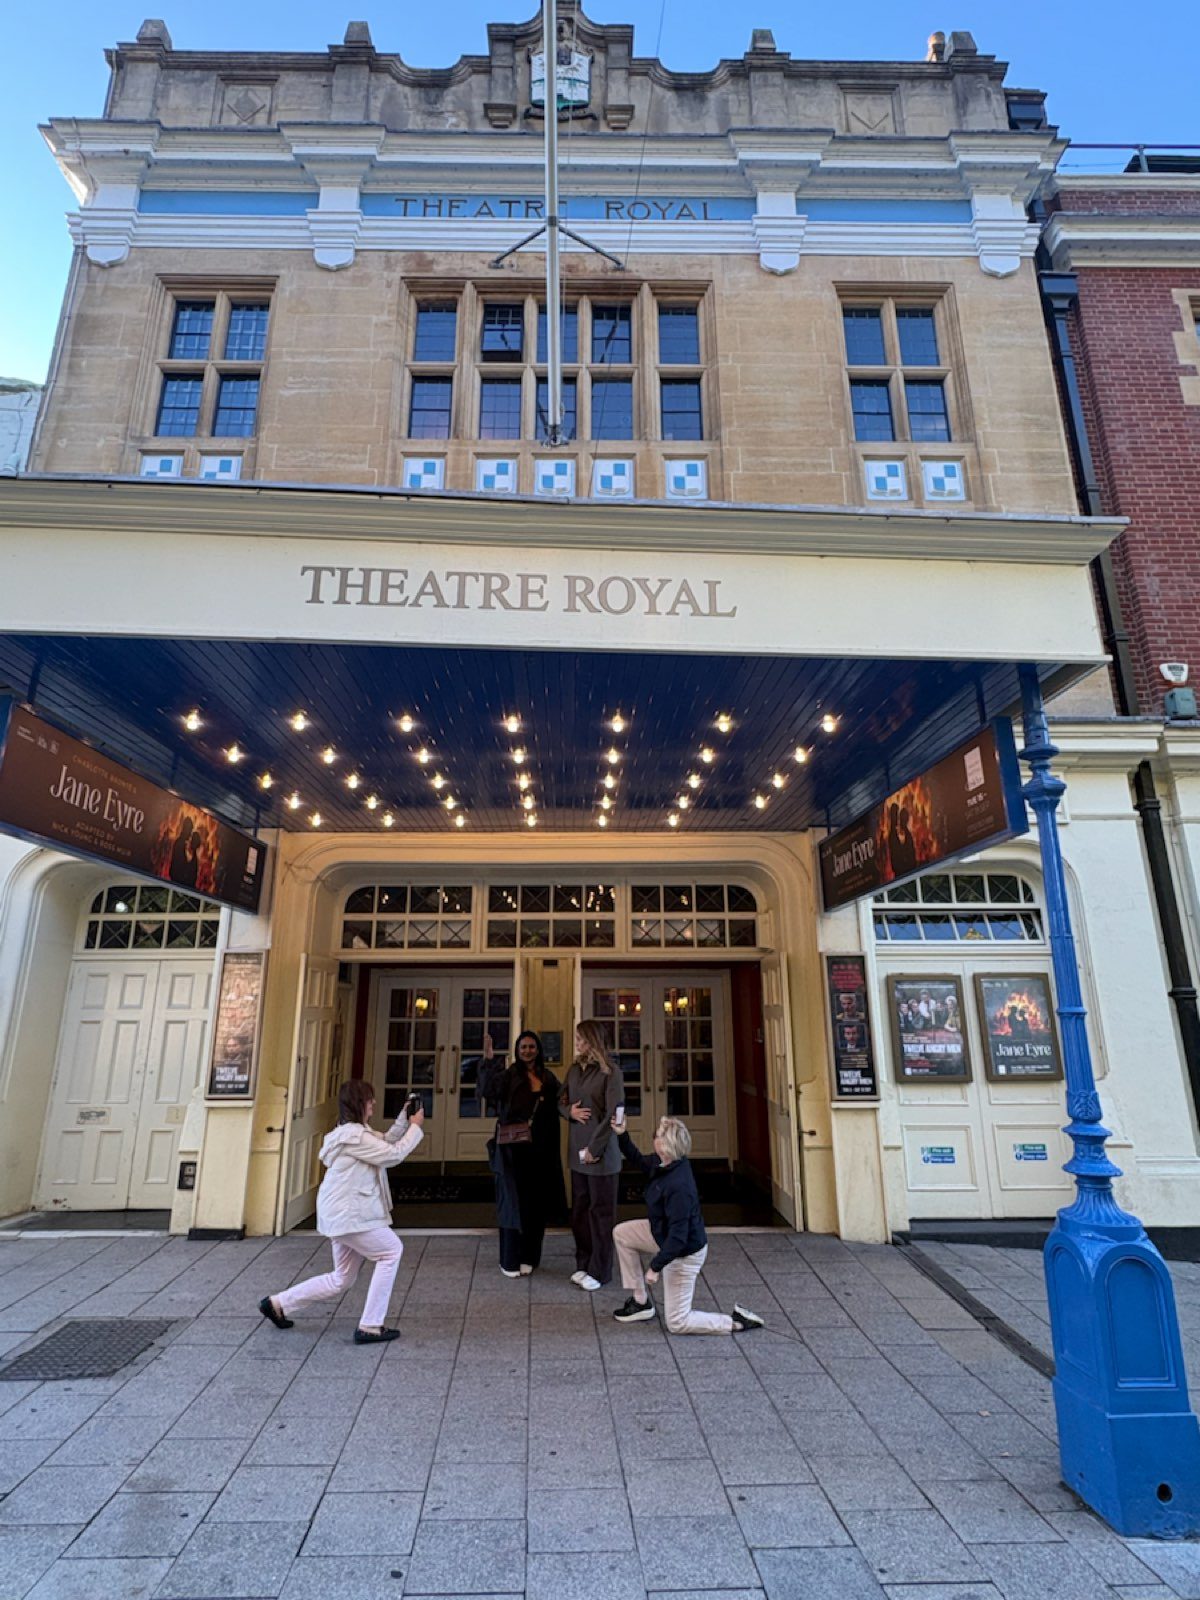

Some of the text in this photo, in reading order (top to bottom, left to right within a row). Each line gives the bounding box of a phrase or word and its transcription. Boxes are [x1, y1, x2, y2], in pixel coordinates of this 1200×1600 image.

[605, 200, 722, 220] ROYAL
[301, 566, 737, 617] THEATRE ROYAL
[50, 764, 145, 833] Jane Eyre
[832, 838, 874, 878] Jane Eyre
[996, 1043, 1052, 1058] Jane Eyre
